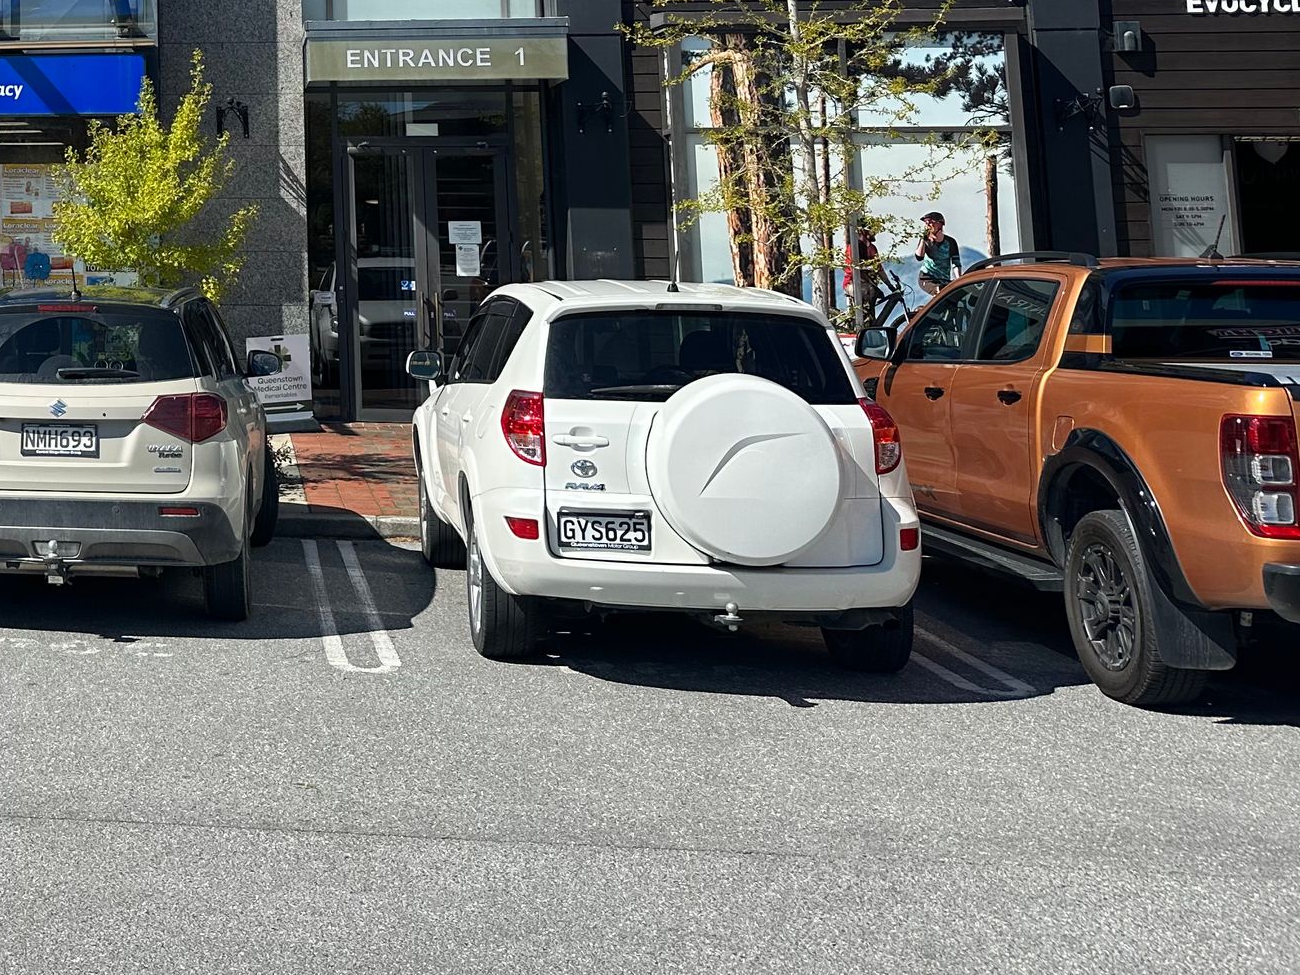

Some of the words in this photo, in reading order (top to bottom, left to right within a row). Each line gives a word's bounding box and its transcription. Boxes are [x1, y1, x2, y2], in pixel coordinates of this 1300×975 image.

[346, 47, 492, 68] ENTRANCE
[514, 47, 525, 66] 1
[257, 375, 304, 385] Queenstown
[282, 383, 308, 392] Centre
[24, 429, 94, 449] NMH693
[565, 481, 607, 491] RAV4
[563, 519, 646, 543] GYS625
[570, 541, 607, 549] Queenstown
[623, 543, 639, 551] Group
